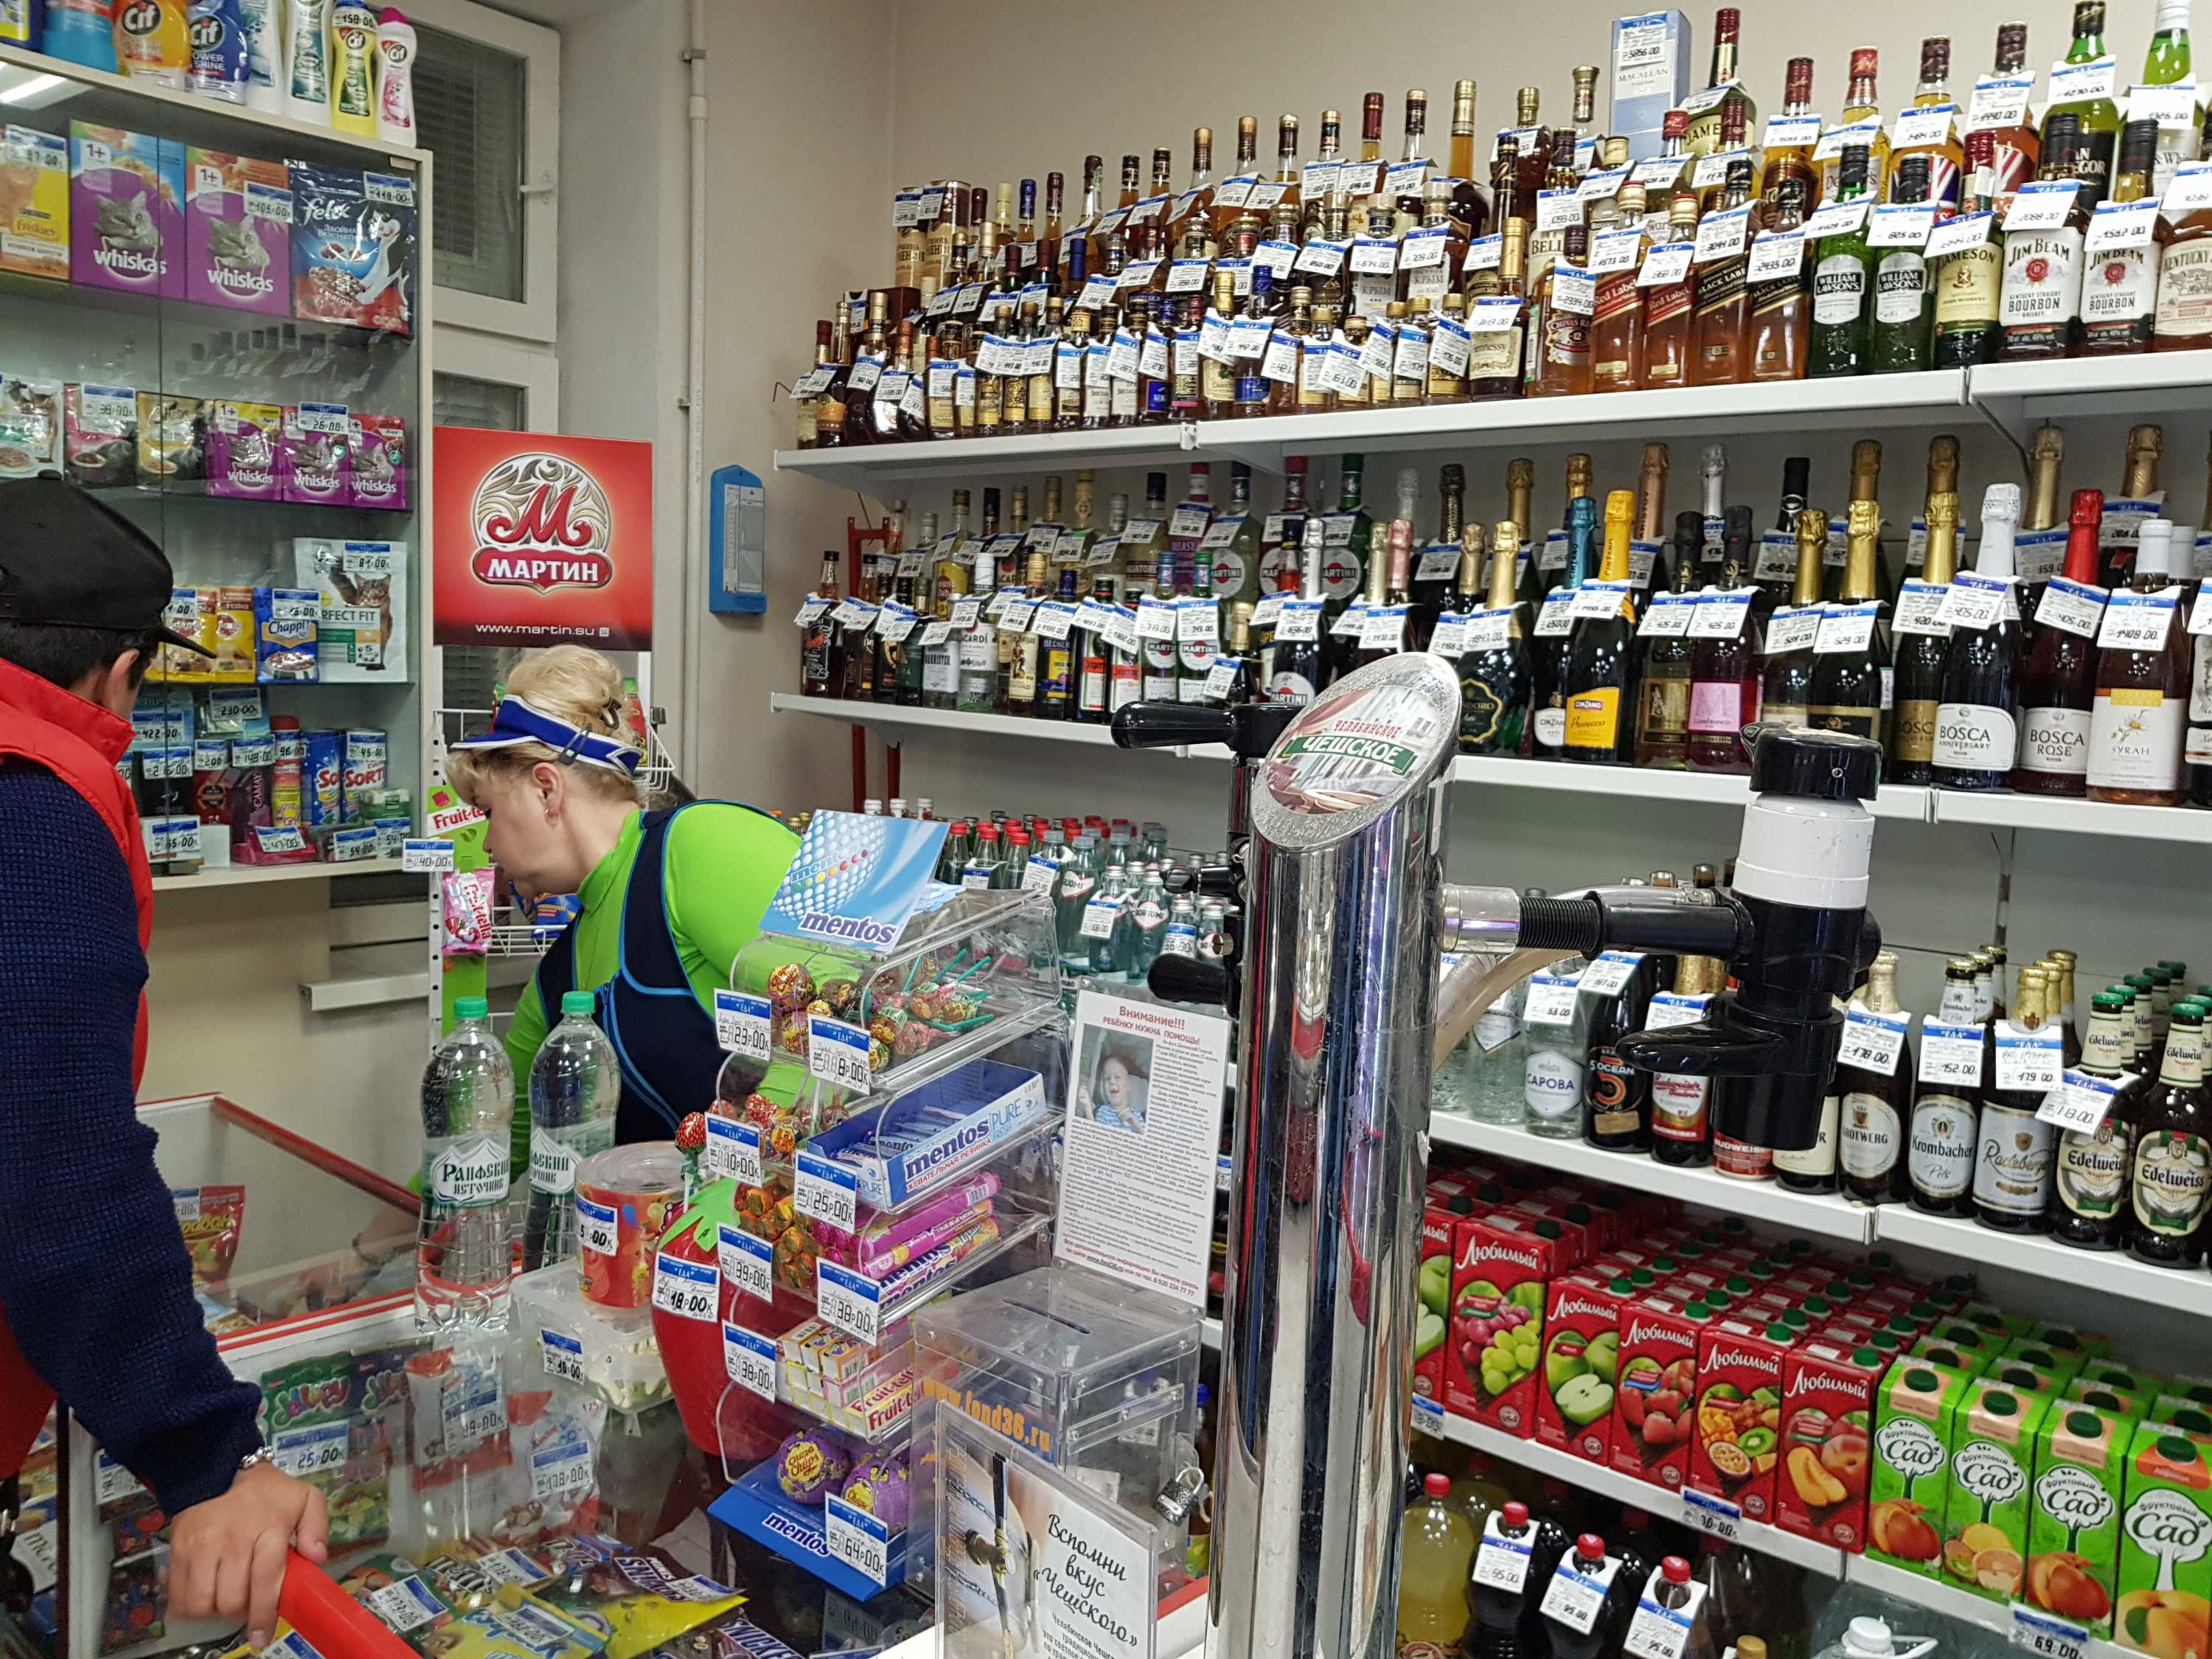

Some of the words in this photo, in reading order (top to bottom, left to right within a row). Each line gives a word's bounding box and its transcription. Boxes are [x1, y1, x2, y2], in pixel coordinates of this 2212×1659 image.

[123, 4, 157, 29] Cif
[192, 19, 219, 44] Cif
[348, 31, 366, 47] Cif
[389, 46, 407, 60] Cif
[1618, 67, 1669, 83] MACALLAN
[1686, 123, 1722, 146] JAME
[86, 145, 104, 161] 1+
[201, 168, 218, 183] 1+
[303, 199, 350, 222] felix
[1531, 239, 1563, 254] BELL
[2009, 245, 2031, 267] JIM
[2035, 239, 2070, 261] BEAM
[94, 250, 167, 275] whiskas
[1939, 248, 1997, 267] JAMESON
[2165, 251, 2208, 267] KENTUCKY
[207, 270, 274, 292] whiskas
[1413, 274, 1444, 285] КРЫМ
[1725, 267, 1747, 283] LABE
[1818, 274, 1857, 285] WILLIAM
[1879, 271, 1919, 281] WILLIAM
[1363, 285, 1392, 296] КРЫМ
[1817, 281, 1860, 294] LAWSON'S
[1879, 279, 1921, 291] LAWSON'S
[1666, 287, 1690, 304] Label
[2089, 296, 2135, 310] BOURBON
[2008, 297, 2060, 313] BOURBON
[227, 470, 274, 484] whiskas
[294, 475, 340, 490] whiskas
[352, 479, 397, 493] whiskas
[488, 558, 598, 582] МАРТИН
[1571, 543, 1579, 580] CINZANO
[1211, 568, 1241, 578] ARTINI
[359, 611, 375, 621] FIT
[476, 624, 594, 636] www.martin.su
[960, 635, 988, 644] CARDÍ
[1043, 639, 1071, 648] BECHER
[1148, 642, 1177, 652] MARTI
[1182, 644, 1216, 653] MARTINI
[1463, 702, 1495, 710] NDORO
[1574, 701, 1601, 709] CINZANO
[1334, 719, 1402, 738] ЧЕЛЯБИНСКОЕ
[1540, 718, 1565, 727] CINZAN
[1570, 717, 1606, 728] Prosecco
[1940, 725, 1991, 742] BOSCA
[2030, 728, 2084, 746] BOSCA
[1302, 736, 1404, 764] ЧЕШСКОЕ
[1939, 740, 1992, 750] ANNIVERSARY
[2037, 745, 2073, 757] ROSE
[2112, 746, 2152, 757] SYRAH
[253, 772, 262, 808] CAMAY
[434, 807, 484, 829] Fruit-te
[801, 913, 895, 945] mentos
[1103, 1016, 1133, 1029] РЕБЁНКУ
[1135, 1023, 1161, 1036] НУЖНА
[1119, 1005, 1186, 1030] Внимание!!!
[1596, 1063, 1635, 1075] OCEAN
[1528, 1073, 1575, 1091] САРОВА
[906, 1118, 990, 1179] mentos
[991, 1099, 1022, 1129] PURE
[1714, 1138, 1771, 1154] BUDWEIS
[1912, 1137, 1973, 1160] Krombacher
[907, 1156, 959, 1192] ЖЕВАТЕЛЬНАЯ
[960, 1138, 992, 1160] РЕЗИНКА
[1983, 1138, 2053, 1180] Radeberg
[1928, 1164, 1951, 1179] Pils
[2141, 1166, 2205, 1187] Edelweiss
[863, 1182, 883, 1195] PURE
[1455, 1235, 1539, 1270] Любимый
[1548, 1292, 1618, 1322] Любимый
[1621, 1318, 1694, 1349] Любимый
[1699, 1343, 1779, 1376] Любимый
[852, 1368, 912, 1412] Fruit-tell
[1785, 1367, 1868, 1400] Любимый
[1886, 1438, 1935, 1464] Сад
[1963, 1463, 2013, 1490] Сад
[2047, 1487, 2099, 1516] Сад
[764, 1514, 830, 1556] mentos
[2133, 1512, 2199, 1546] Сад
[1048, 1513, 1126, 1581] Вспомни
[1066, 1554, 1105, 1598] вкус
[1033, 1568, 1137, 1647] «Чешского»
